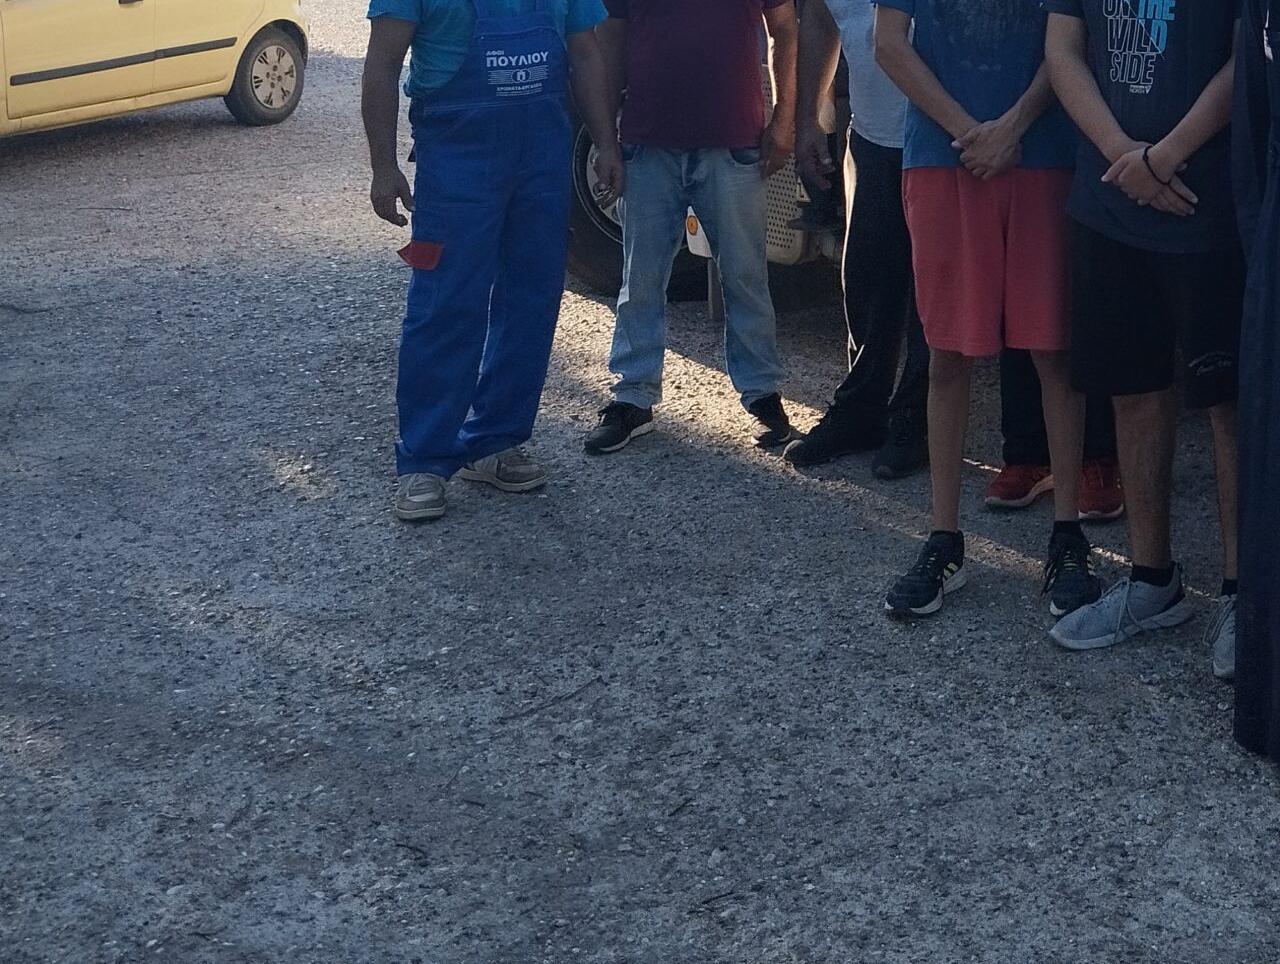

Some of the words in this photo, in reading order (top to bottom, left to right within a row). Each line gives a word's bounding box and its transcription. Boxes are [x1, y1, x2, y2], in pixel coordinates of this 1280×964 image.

[1107, 17, 1168, 55] WILD
[486, 51, 549, 67] ΠΟΥΛΙΟΥ
[1110, 50, 1157, 85] SIDE
